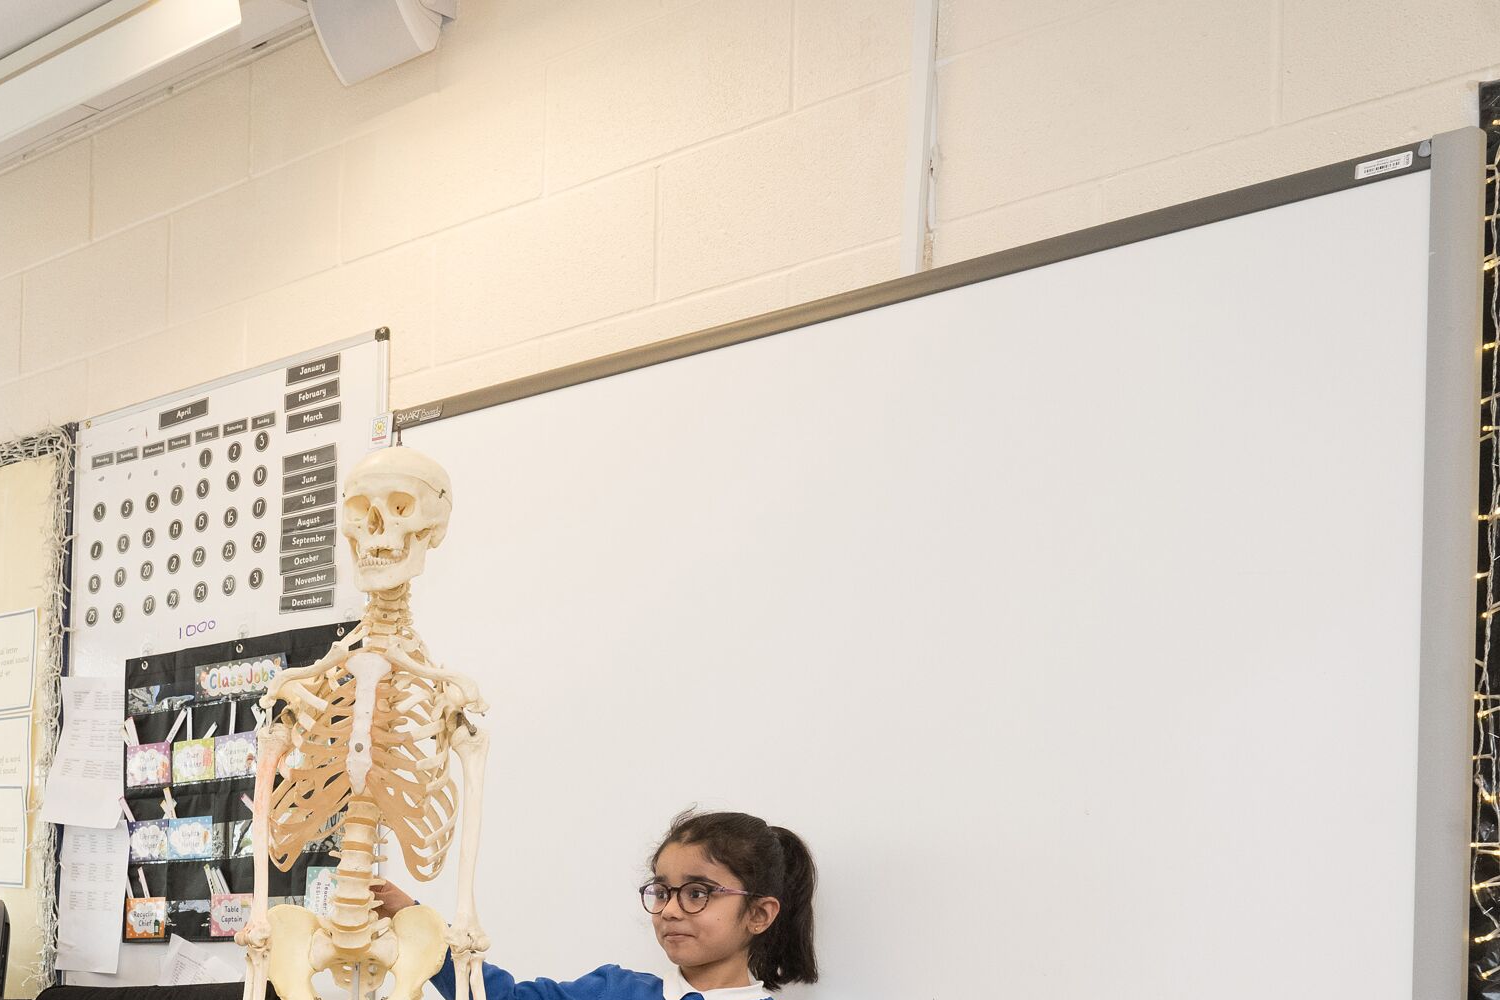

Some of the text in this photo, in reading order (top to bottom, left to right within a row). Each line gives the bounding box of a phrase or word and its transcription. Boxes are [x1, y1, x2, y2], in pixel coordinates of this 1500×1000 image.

[300, 362, 326, 376] January
[298, 388, 326, 402] February
[176, 407, 192, 419] April
[303, 413, 323, 423] March
[396, 408, 422, 424] SMART
[201, 430, 213, 440] Friday
[232, 446, 237, 457] 2
[259, 435, 264, 447] 3
[302, 453, 317, 463] May
[301, 475, 317, 484] June
[124, 503, 130, 513] 5
[150, 497, 154, 508] 6
[174, 489, 179, 501] 7
[200, 483, 205, 494] 8
[231, 476, 236, 486] 9
[256, 470, 263, 481] 10
[302, 494, 316, 505] July
[145, 533, 151, 543] 13
[198, 516, 205, 527] 15
[227, 511, 234, 523] 16
[256, 502, 262, 513] 17
[296, 516, 320, 527] August
[292, 534, 326, 547] September
[143, 565, 150, 576] 20
[171, 558, 177, 569] 21
[195, 551, 202, 562] 22
[225, 545, 233, 557] 23
[255, 536, 263, 548] 24
[294, 554, 319, 565] October
[295, 574, 327, 586] November
[88, 612, 96, 622] 25
[115, 608, 122, 618] 26
[198, 586, 205, 597] 29
[225, 580, 233, 591] 30
[253, 573, 259, 584] 31
[292, 596, 322, 607] December
[179, 620, 216, 639] 1000
[15, 655, 29, 663] sound
[210, 666, 276, 689] Class Jobs
[221, 916, 242, 924] Captain
